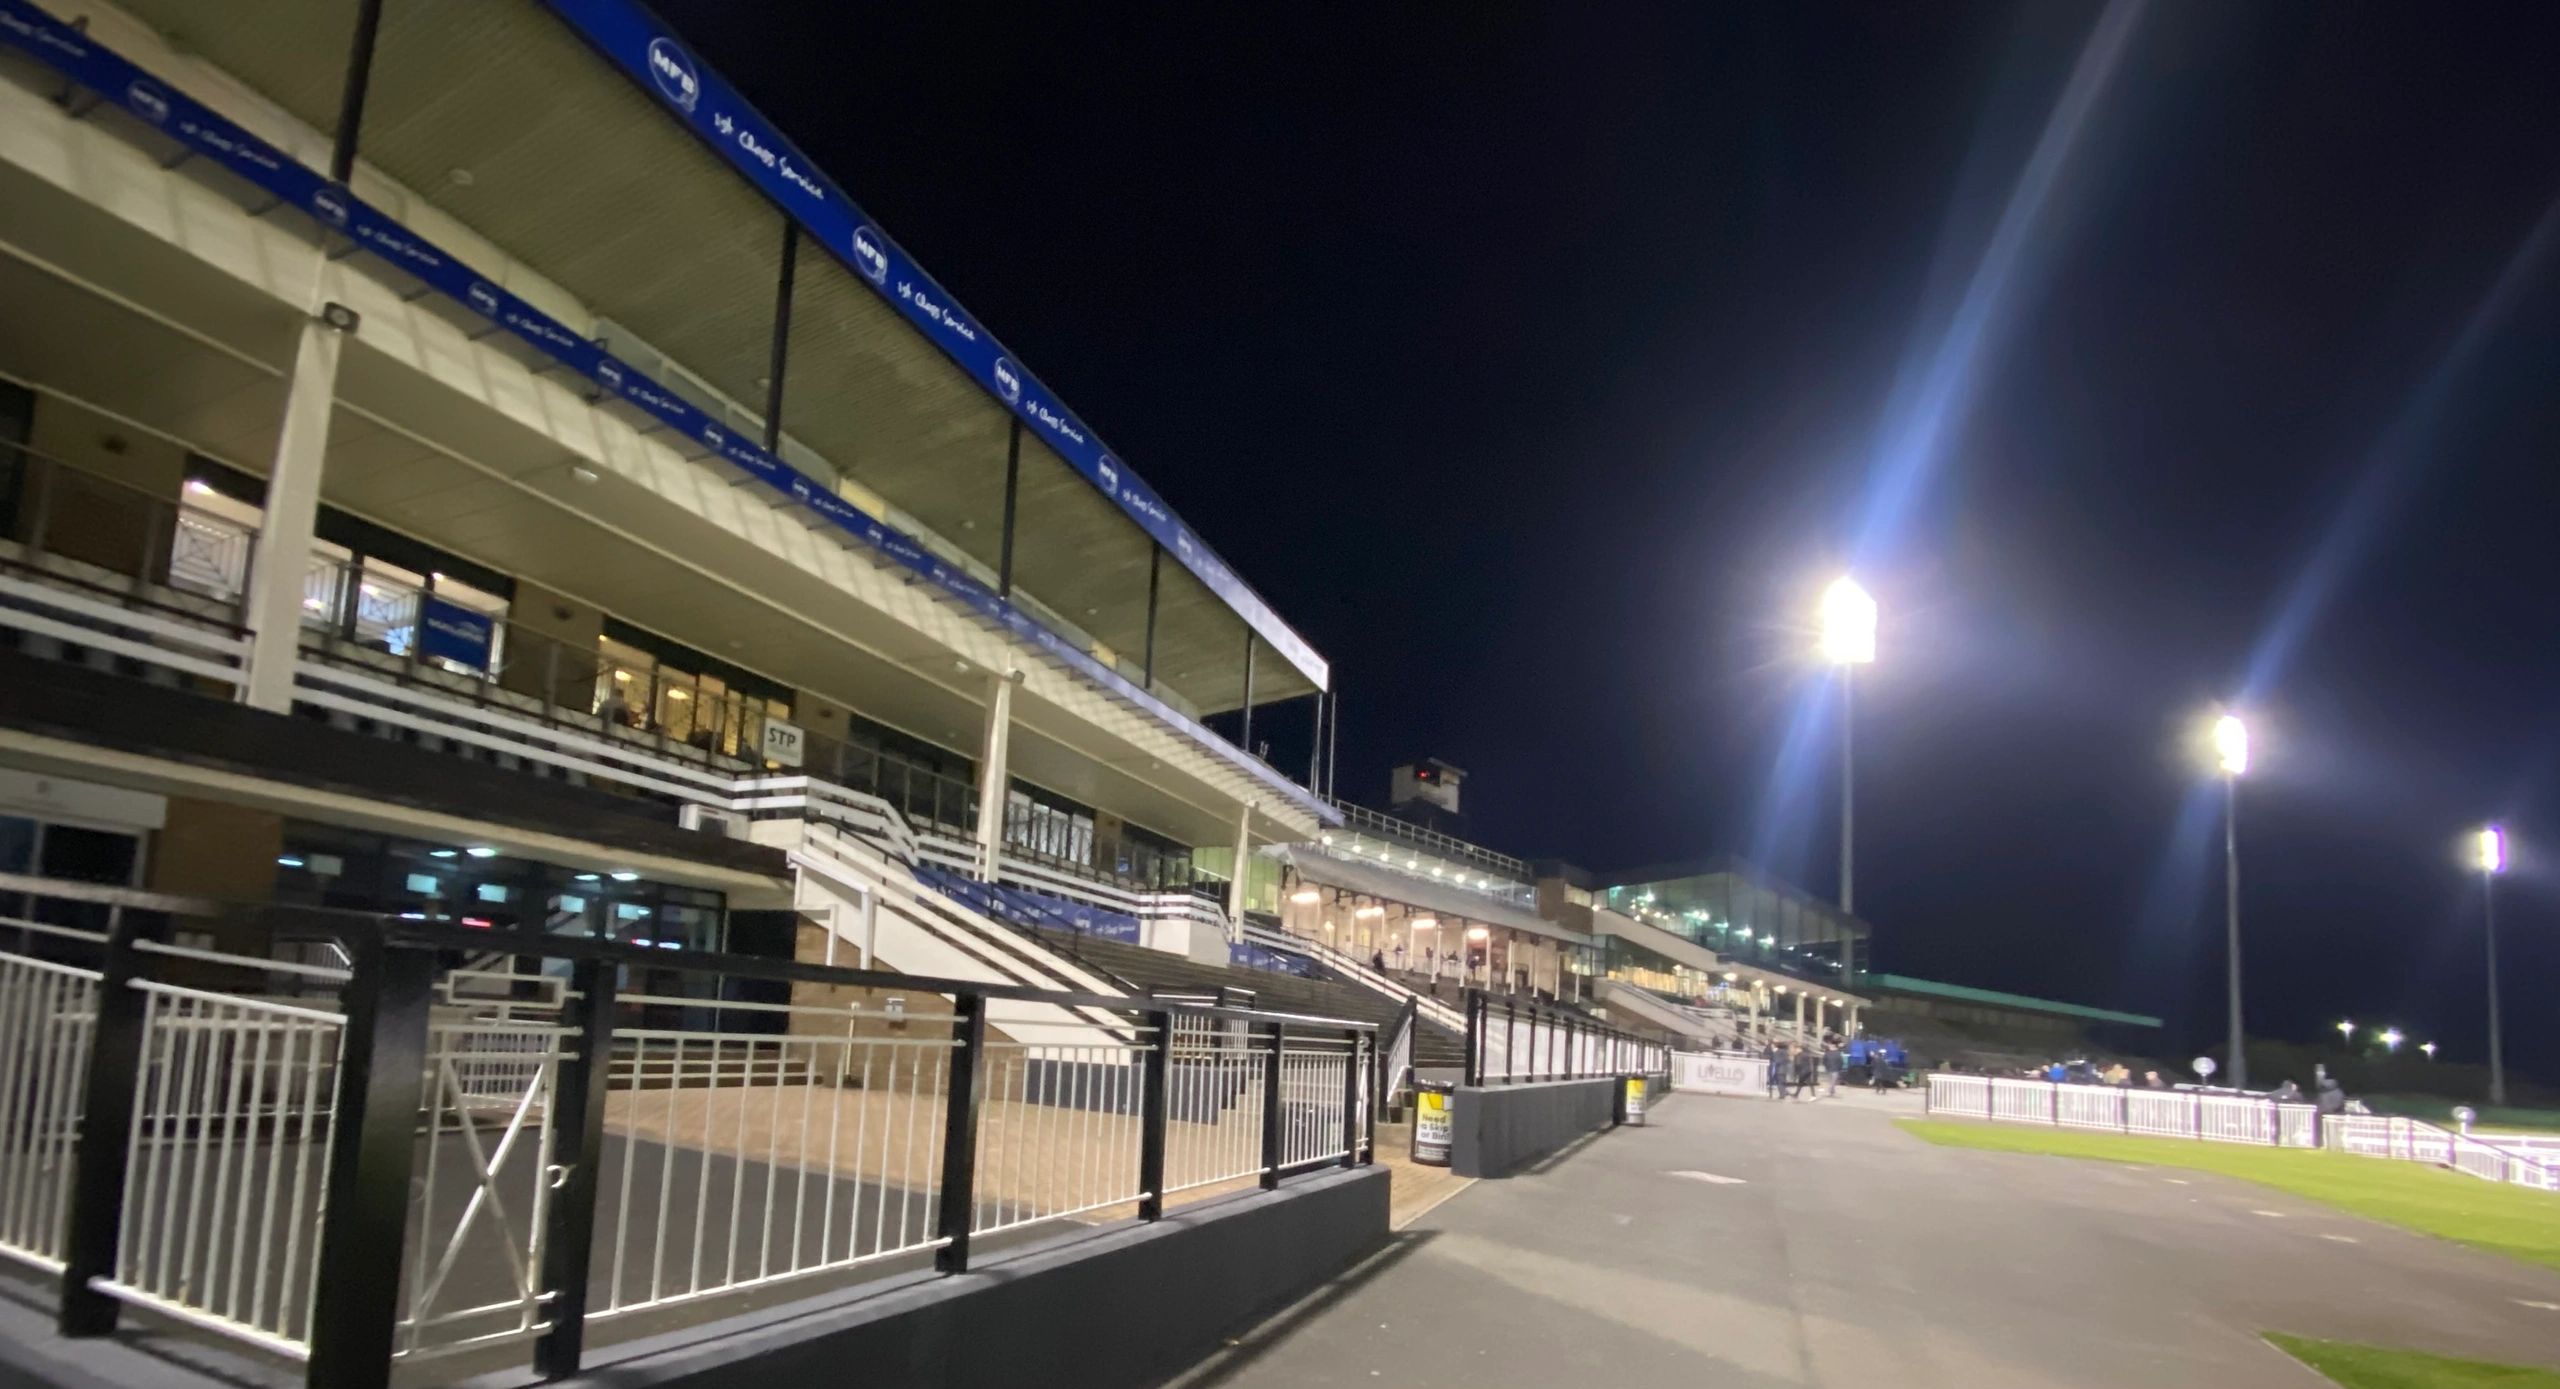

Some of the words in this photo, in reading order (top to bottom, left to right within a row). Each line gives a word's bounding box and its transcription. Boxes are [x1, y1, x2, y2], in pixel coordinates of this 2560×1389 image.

[654, 48, 695, 94] MFB
[856, 236, 885, 269] MFB
[768, 727, 796, 748] STP
[1422, 1113, 1447, 1124] Need
[1429, 1123, 1449, 1133] Skip
